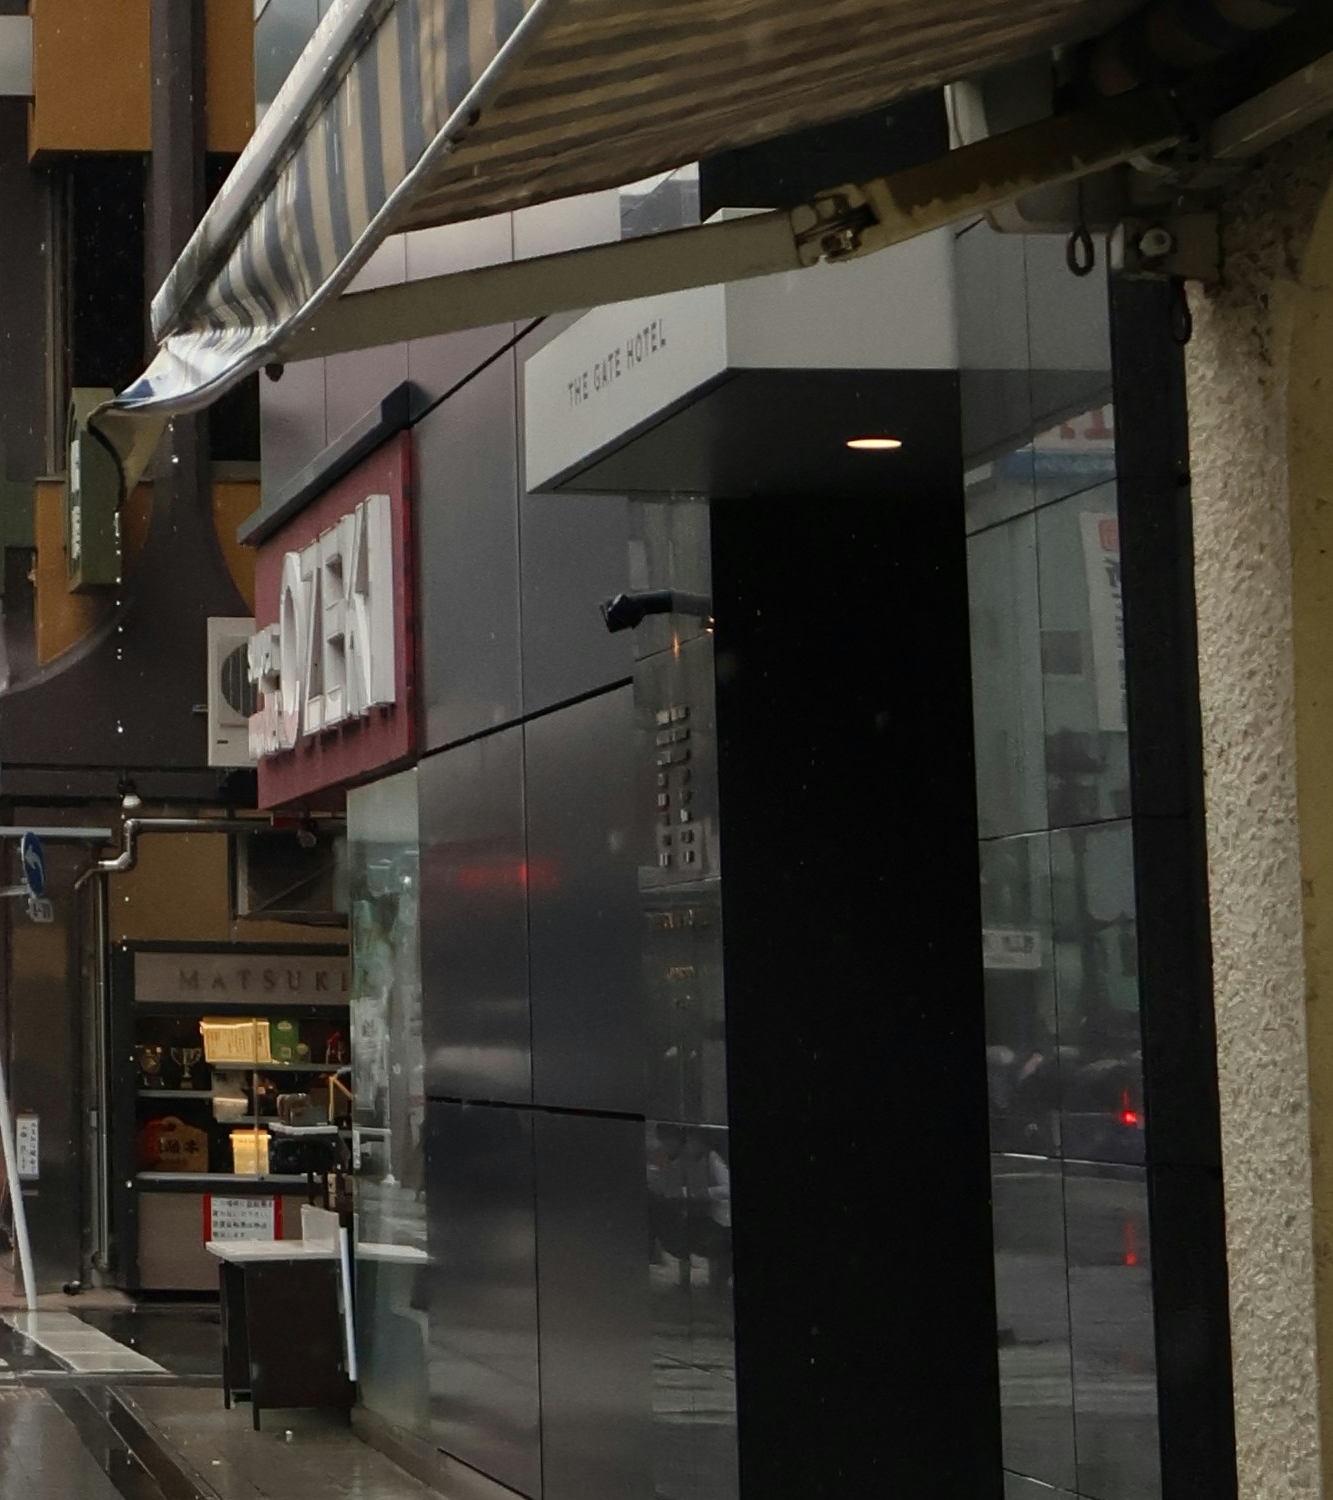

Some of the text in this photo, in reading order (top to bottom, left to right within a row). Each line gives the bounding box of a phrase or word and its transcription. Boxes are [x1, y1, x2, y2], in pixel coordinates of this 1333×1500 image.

[568, 318, 667, 409] THE GATE HOTEL
